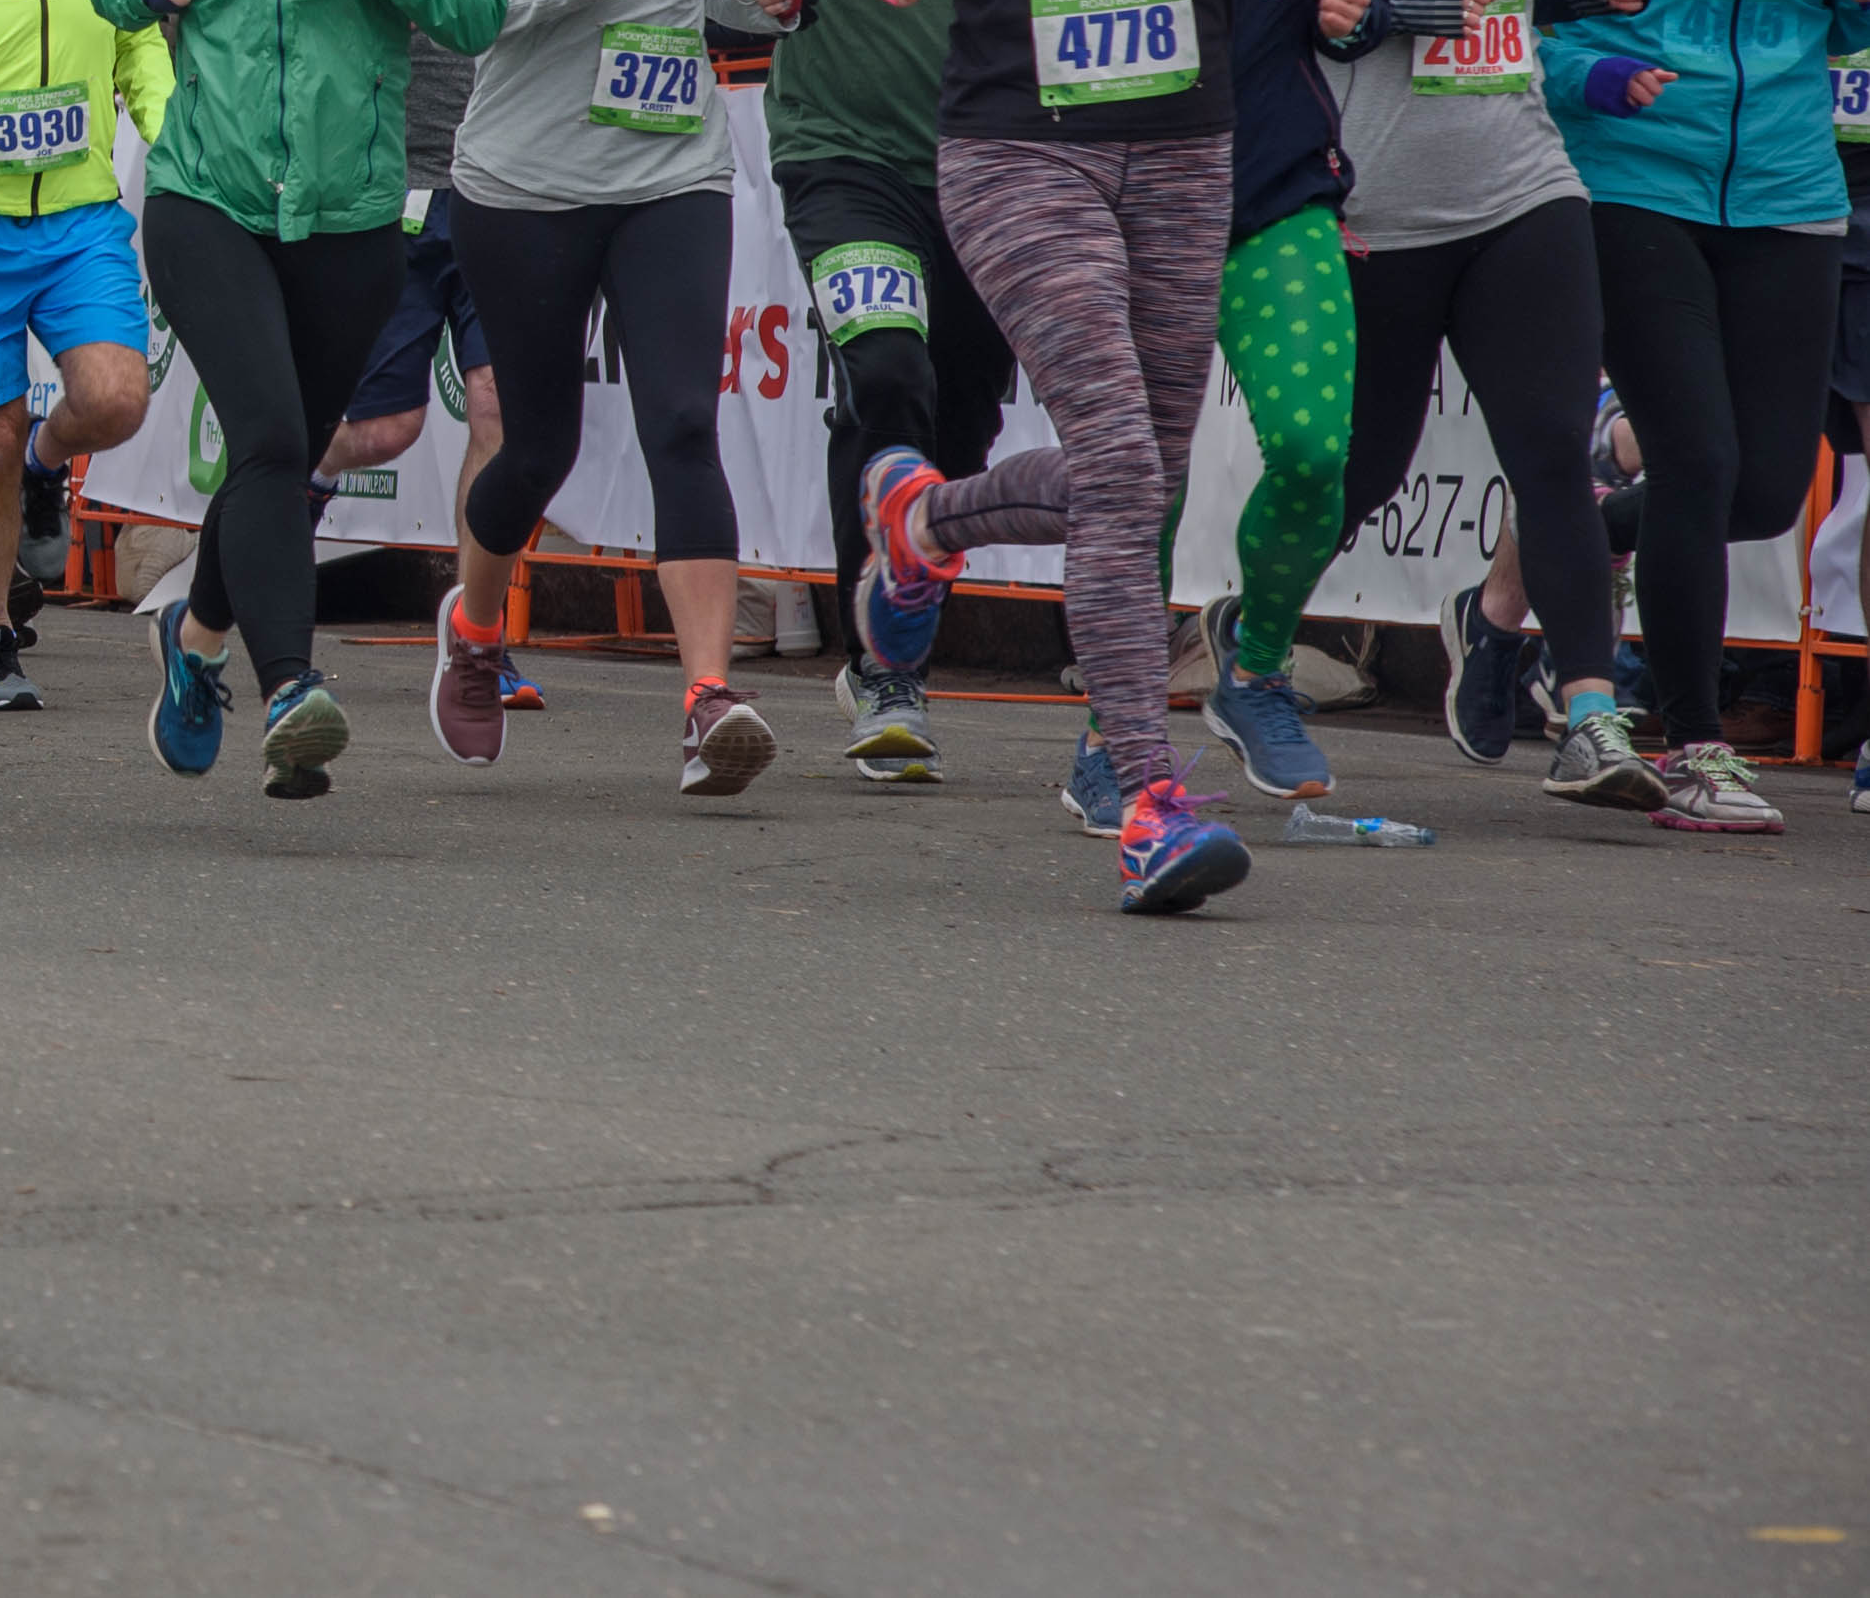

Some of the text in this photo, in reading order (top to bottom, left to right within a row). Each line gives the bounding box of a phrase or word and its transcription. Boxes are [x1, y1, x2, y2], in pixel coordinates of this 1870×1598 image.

[1056, 4, 1177, 70] 4778
[1423, 14, 1524, 66] 2608
[610, 52, 699, 106] 3728
[1454, 65, 1504, 75] MAUREEN
[640, 102, 674, 113] KRISTI
[35, 148, 54, 157] JOE
[828, 265, 918, 315] 3727
[865, 303, 894, 312] PAUL
[438, 360, 468, 413] HOLYO
[357, 473, 396, 495] WWLP.COM
